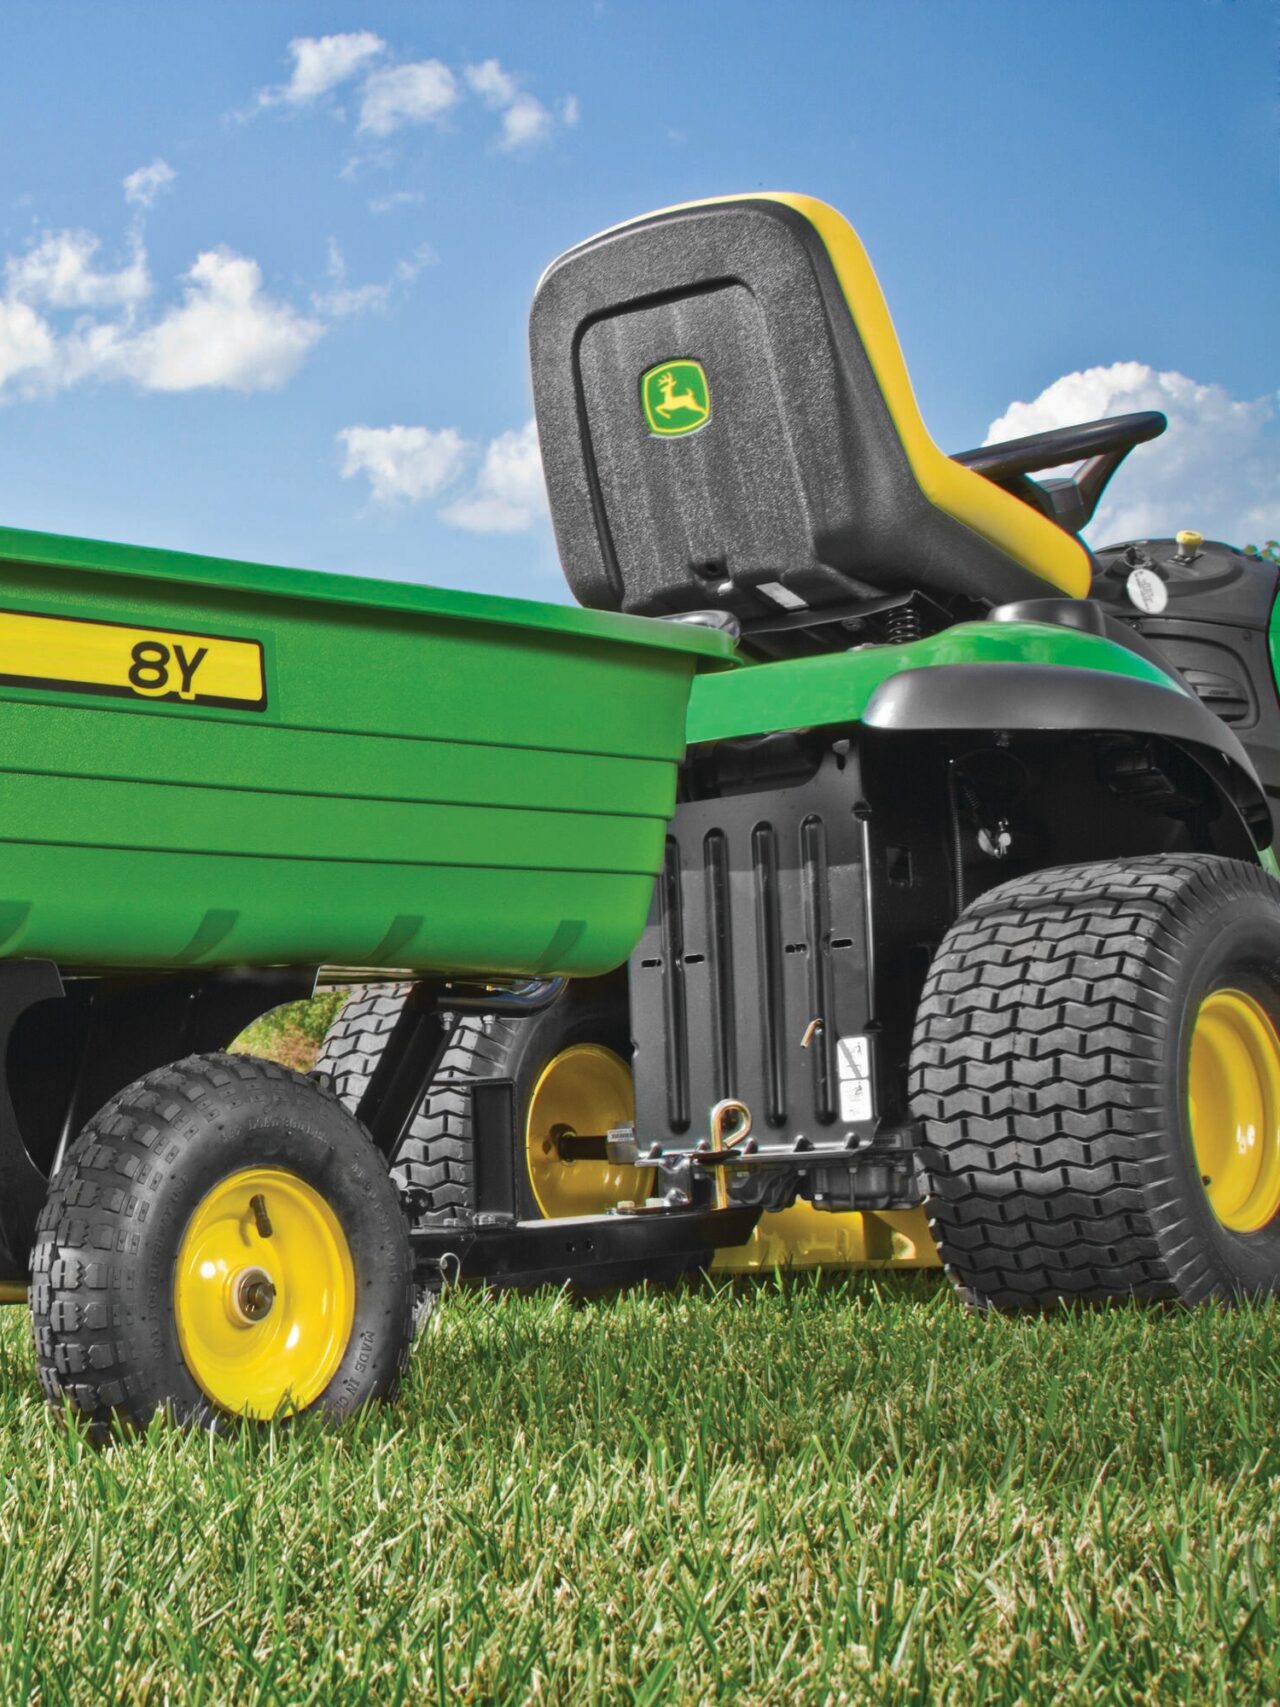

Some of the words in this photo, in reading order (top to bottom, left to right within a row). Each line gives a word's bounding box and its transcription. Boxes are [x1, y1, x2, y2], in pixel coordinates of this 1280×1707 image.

[128, 641, 208, 693] 8Y
[355, 1330, 376, 1374] MADE
[345, 1376, 361, 1397] IN
